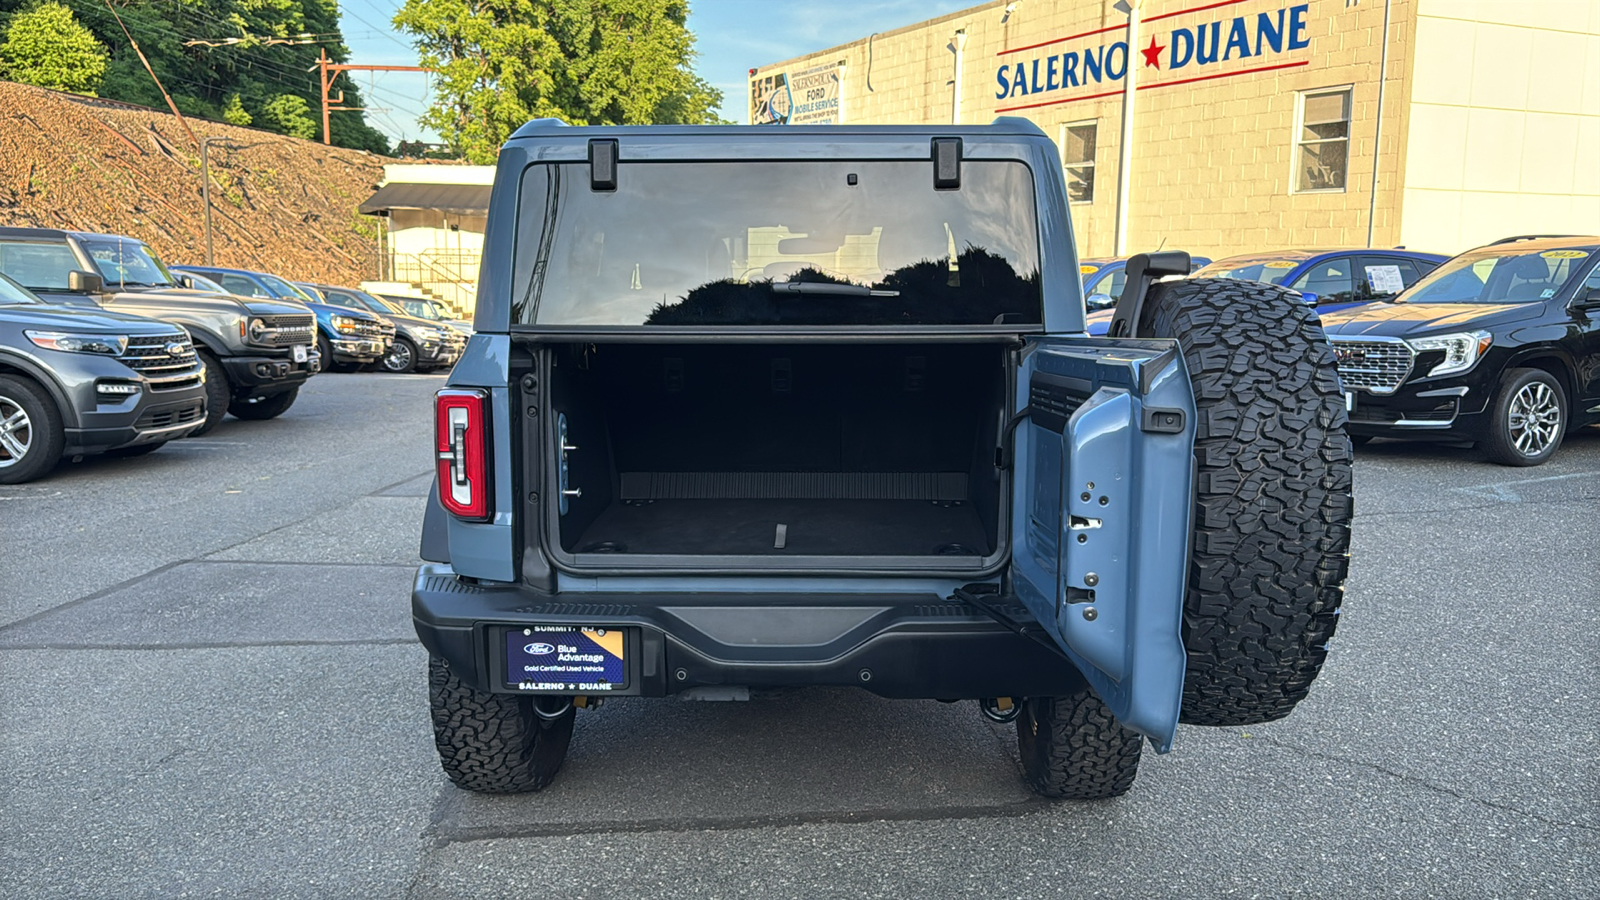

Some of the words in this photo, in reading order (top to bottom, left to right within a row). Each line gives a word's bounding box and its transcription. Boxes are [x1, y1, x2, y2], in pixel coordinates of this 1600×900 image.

[995, 41, 1129, 100] SALERNO
[1169, 3, 1311, 70] DUANE
[807, 87, 825, 101] FORD
[795, 103, 814, 114] MOBILE
[815, 98, 838, 110] SERVICE
[1333, 349, 1365, 360] MC
[528, 643, 551, 654] Ford
[557, 644, 577, 653] Blue
[557, 653, 604, 663] Advantage
[518, 682, 565, 690] SALERNO
[579, 682, 612, 690] DUANE
